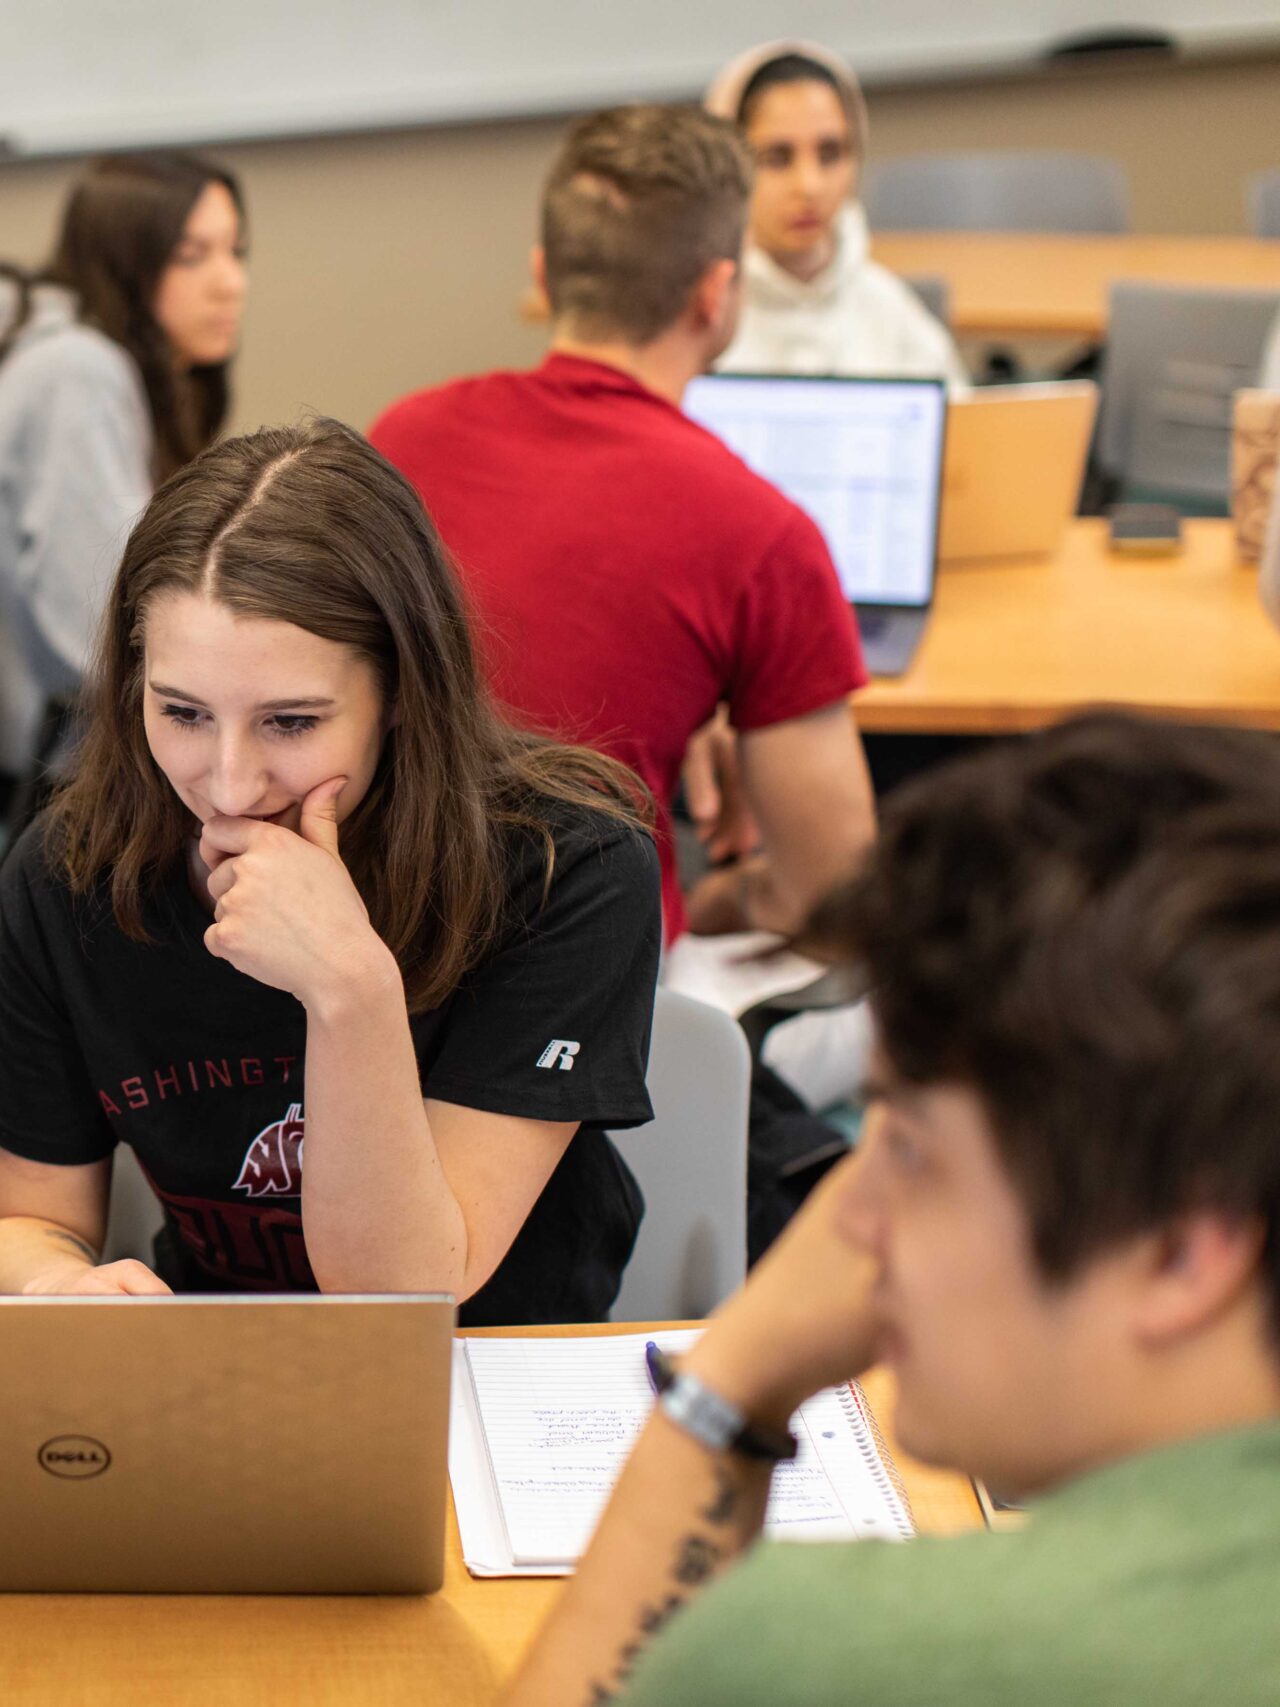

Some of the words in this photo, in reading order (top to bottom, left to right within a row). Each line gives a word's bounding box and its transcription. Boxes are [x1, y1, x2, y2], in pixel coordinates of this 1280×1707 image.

[536, 1039, 581, 1071] R
[99, 1057, 296, 1116] ASHINGT
[46, 1451, 104, 1465] DELL
